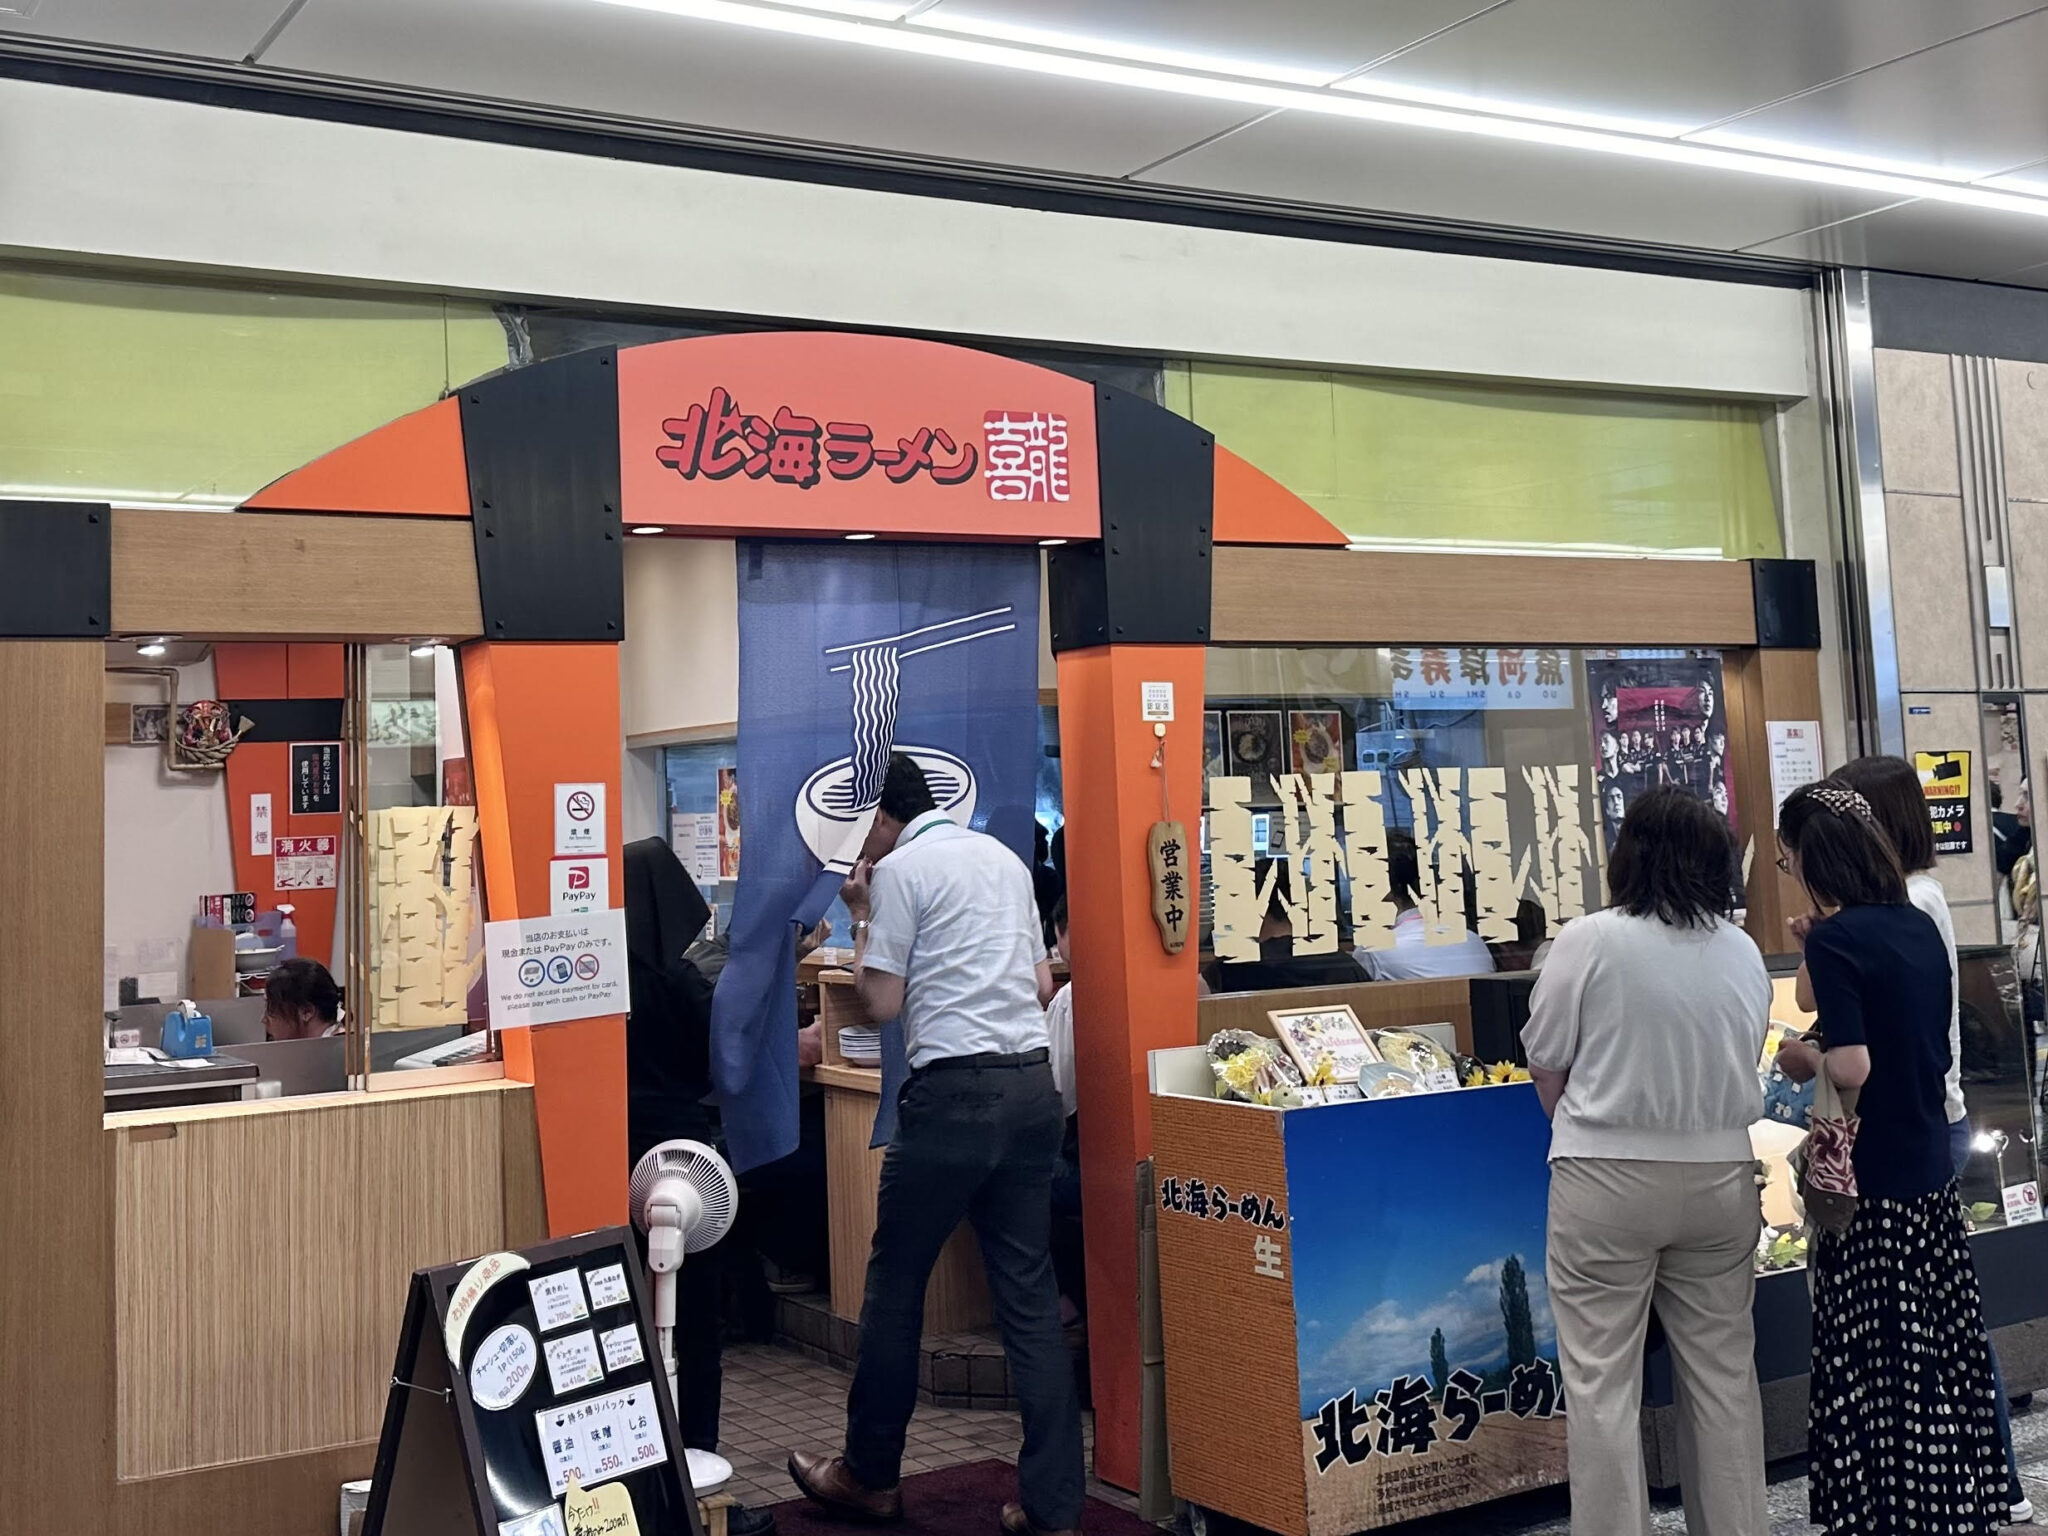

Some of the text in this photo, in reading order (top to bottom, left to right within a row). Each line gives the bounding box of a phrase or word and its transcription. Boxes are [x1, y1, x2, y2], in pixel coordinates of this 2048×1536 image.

[656, 386, 979, 490] 北海ラーメン
[1929, 805, 1965, 819] 犯カメラ
[255, 806, 268, 844] 禁煙
[1160, 839, 1184, 933] 営業中
[563, 892, 596, 902] PayPay
[525, 928, 589, 943] 当店のお支払いは
[501, 946, 542, 958] 現金または
[544, 943, 576, 954] PayPay
[562, 985, 591, 995] payment
[546, 997, 560, 1005] with
[562, 995, 577, 1003] cash
[1160, 1176, 1286, 1231] 北海らーめん
[1254, 1235, 1285, 1279] 生
[567, 1399, 625, 1425] 持ち帰りパック
[1312, 1357, 1567, 1475] 北海らーめ
[628, 1415, 647, 1431] しお
[590, 1425, 612, 1442] 味噌
[552, 1437, 575, 1454] 醤油
